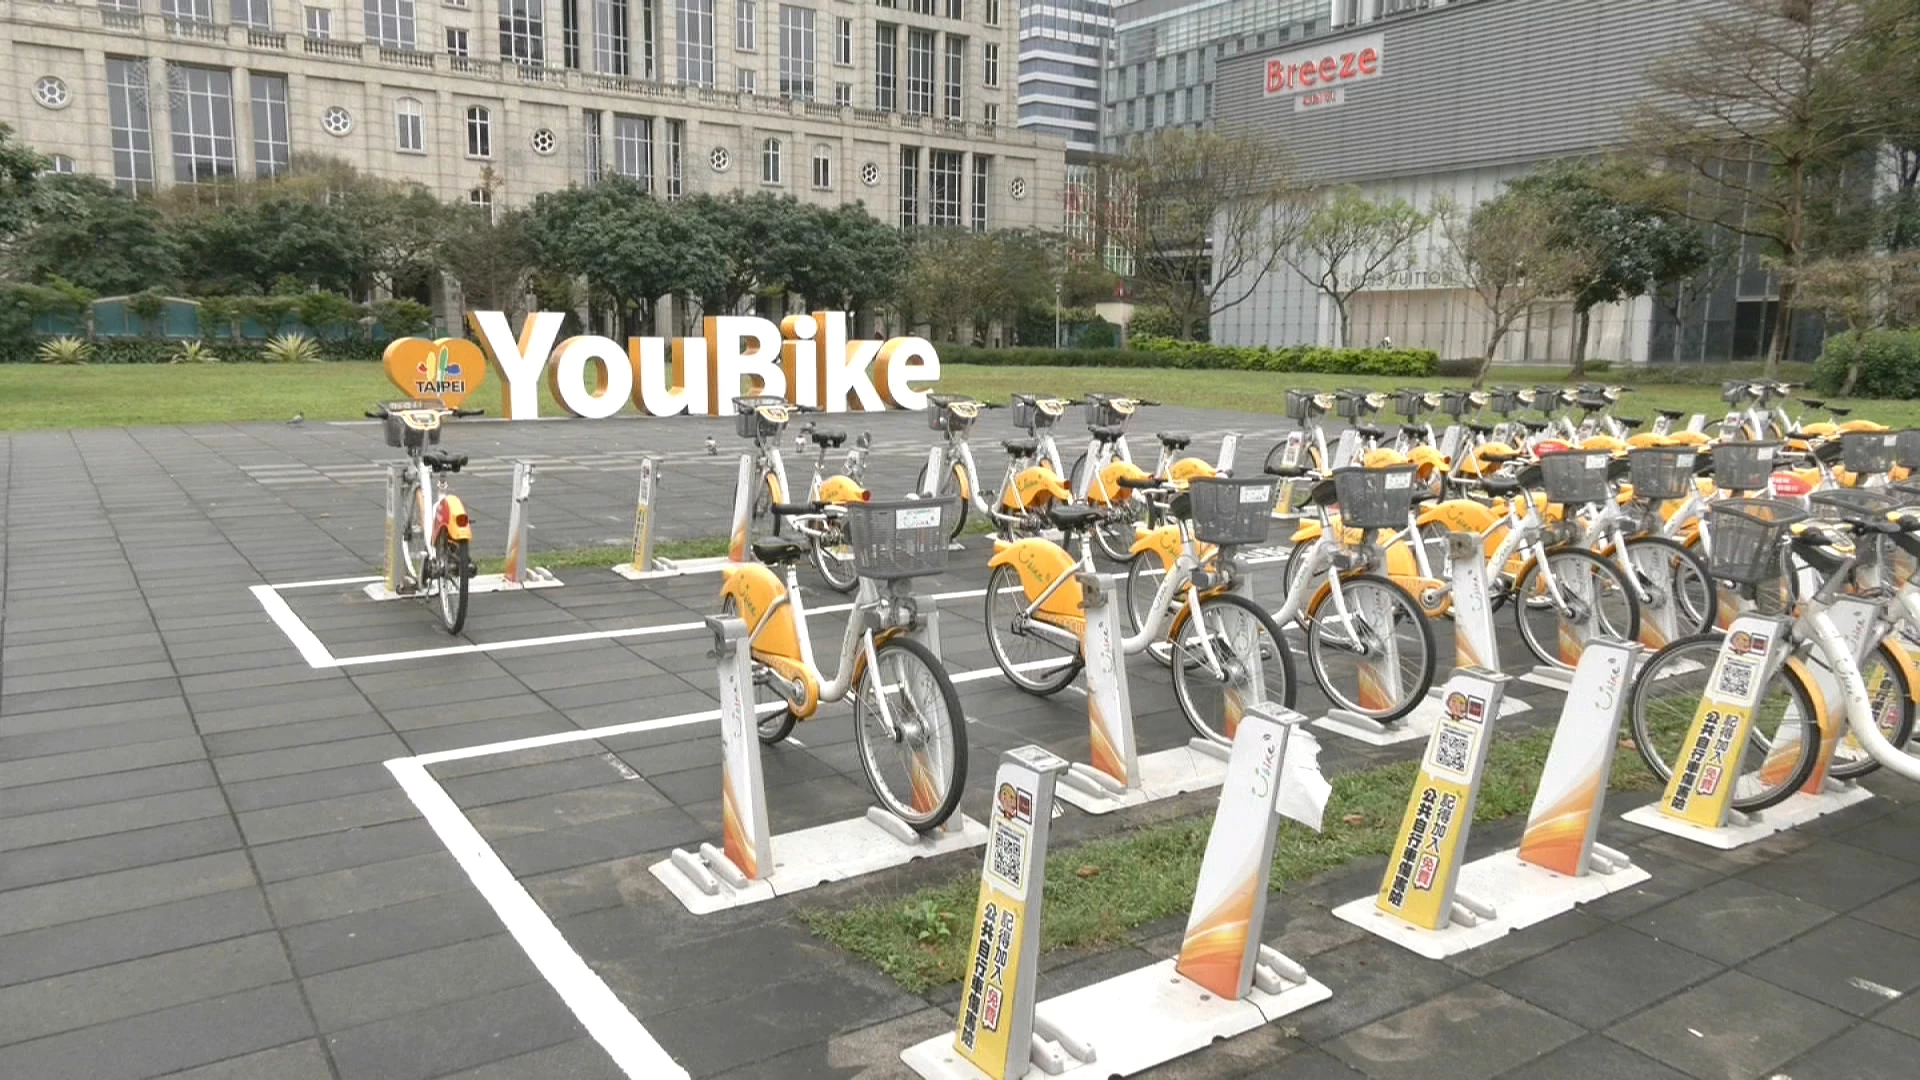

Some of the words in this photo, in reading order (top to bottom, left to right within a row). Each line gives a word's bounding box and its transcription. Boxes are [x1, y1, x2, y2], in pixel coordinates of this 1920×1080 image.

[1267, 47, 1378, 93] Breeze
[416, 381, 466, 393] TAIPEI
[468, 310, 941, 419] YouBike
